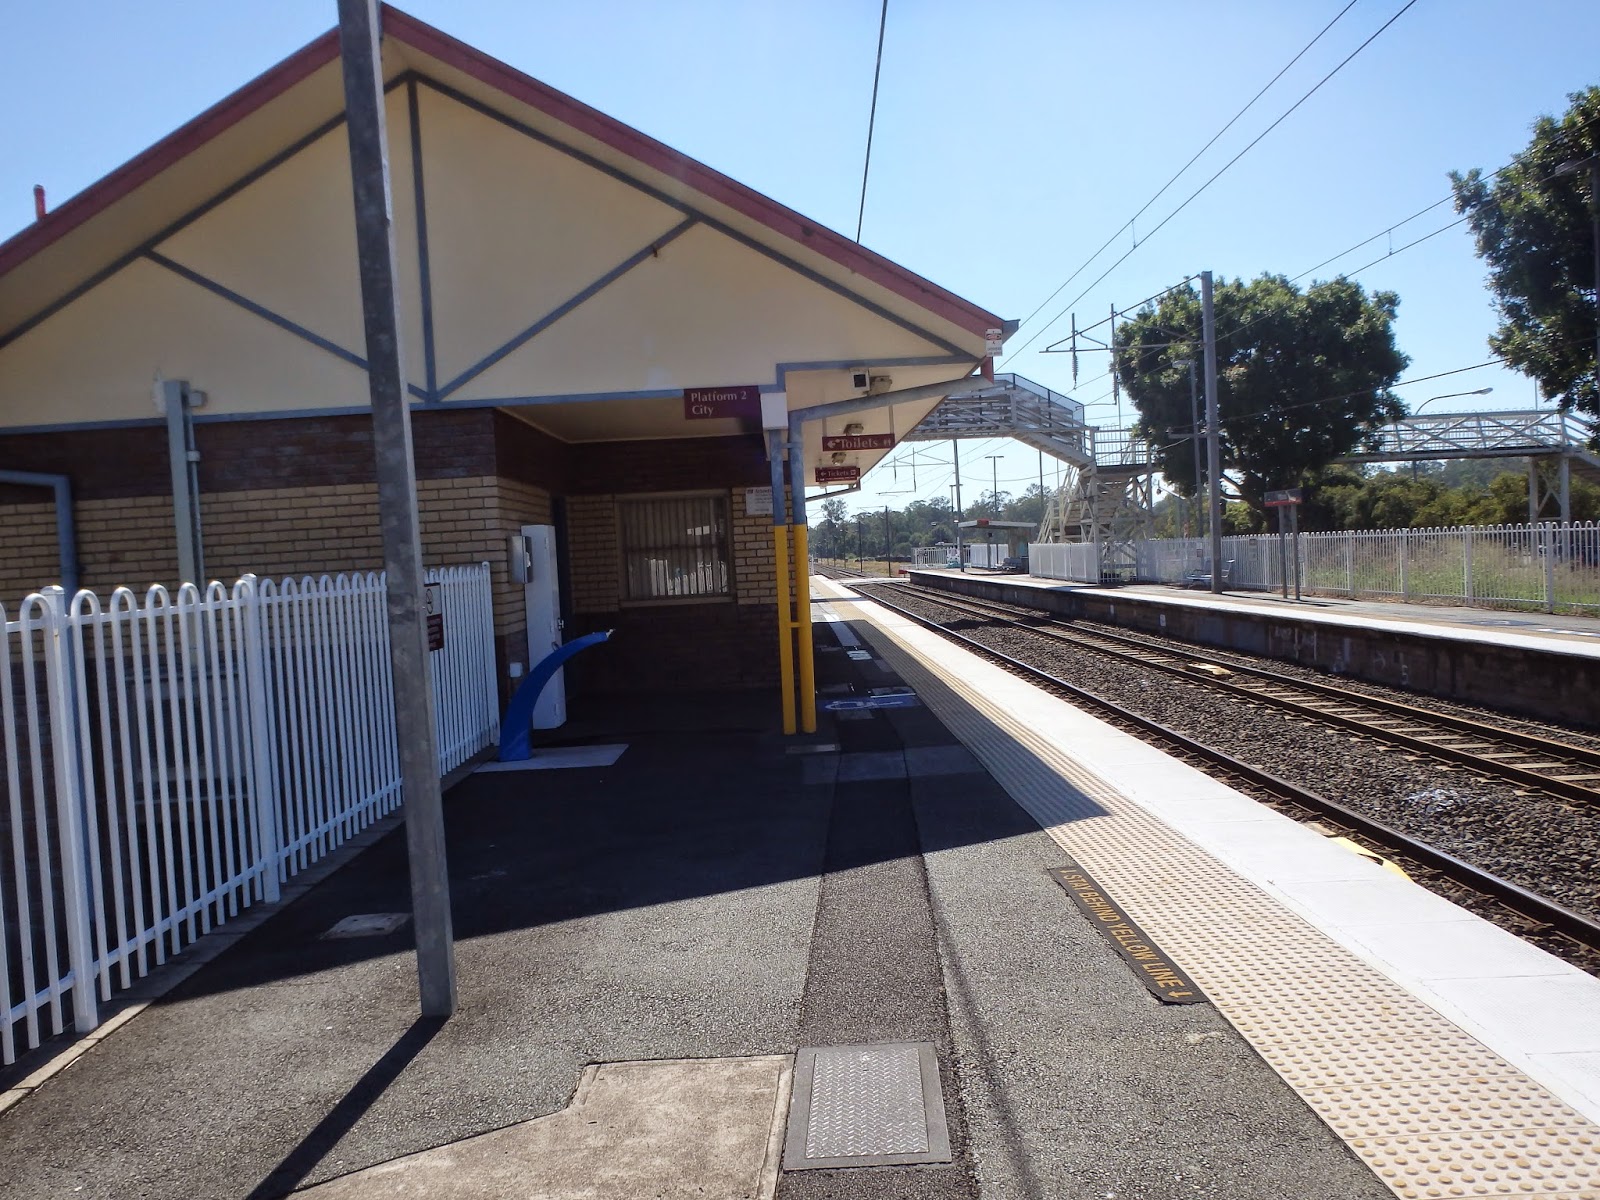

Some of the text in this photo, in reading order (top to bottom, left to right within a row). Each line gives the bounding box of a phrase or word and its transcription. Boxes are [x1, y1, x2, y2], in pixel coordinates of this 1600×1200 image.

[691, 391, 747, 402] Platform 2
[692, 405, 714, 416] City
[840, 438, 878, 449] Toilets
[828, 469, 849, 477] Tickets
[1064, 874, 1185, 988] STAY BEHIND YELLOW LINE
